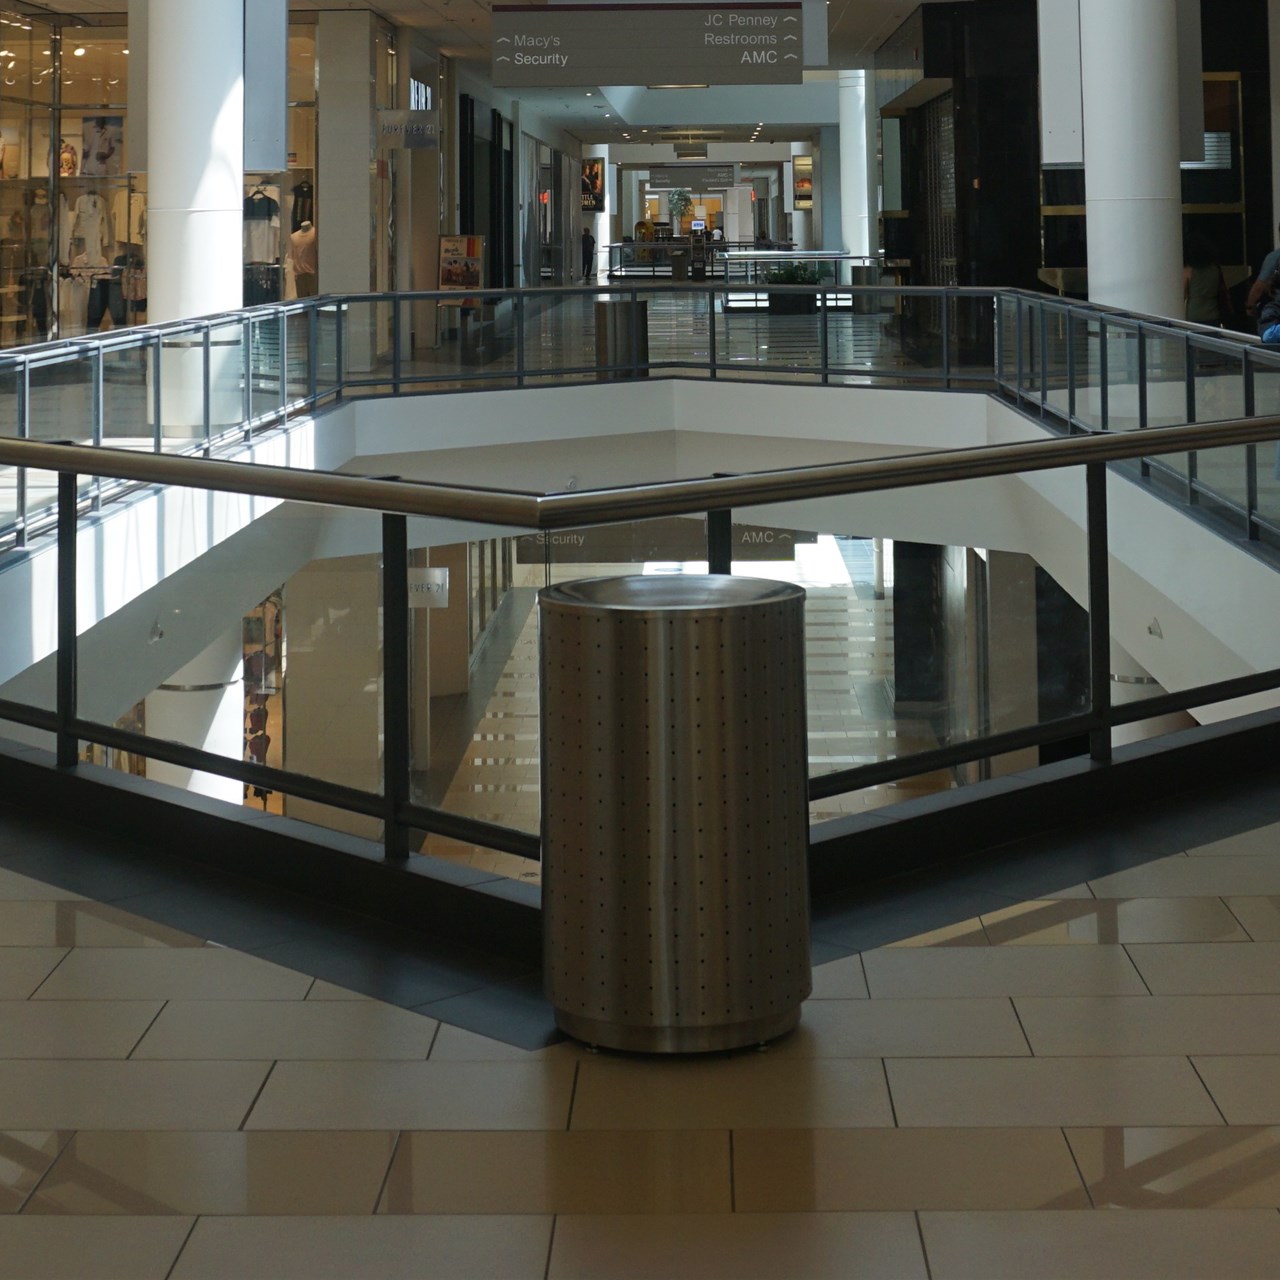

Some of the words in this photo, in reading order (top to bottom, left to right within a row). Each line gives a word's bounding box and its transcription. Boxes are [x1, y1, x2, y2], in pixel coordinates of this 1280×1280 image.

[705, 13, 723, 27] JC
[728, 13, 778, 30] Penney
[514, 34, 560, 47] Macy's
[704, 33, 778, 46] Restrooms
[514, 53, 569, 67] Security
[740, 51, 778, 64] AMC
[741, 530, 774, 543] AMC
